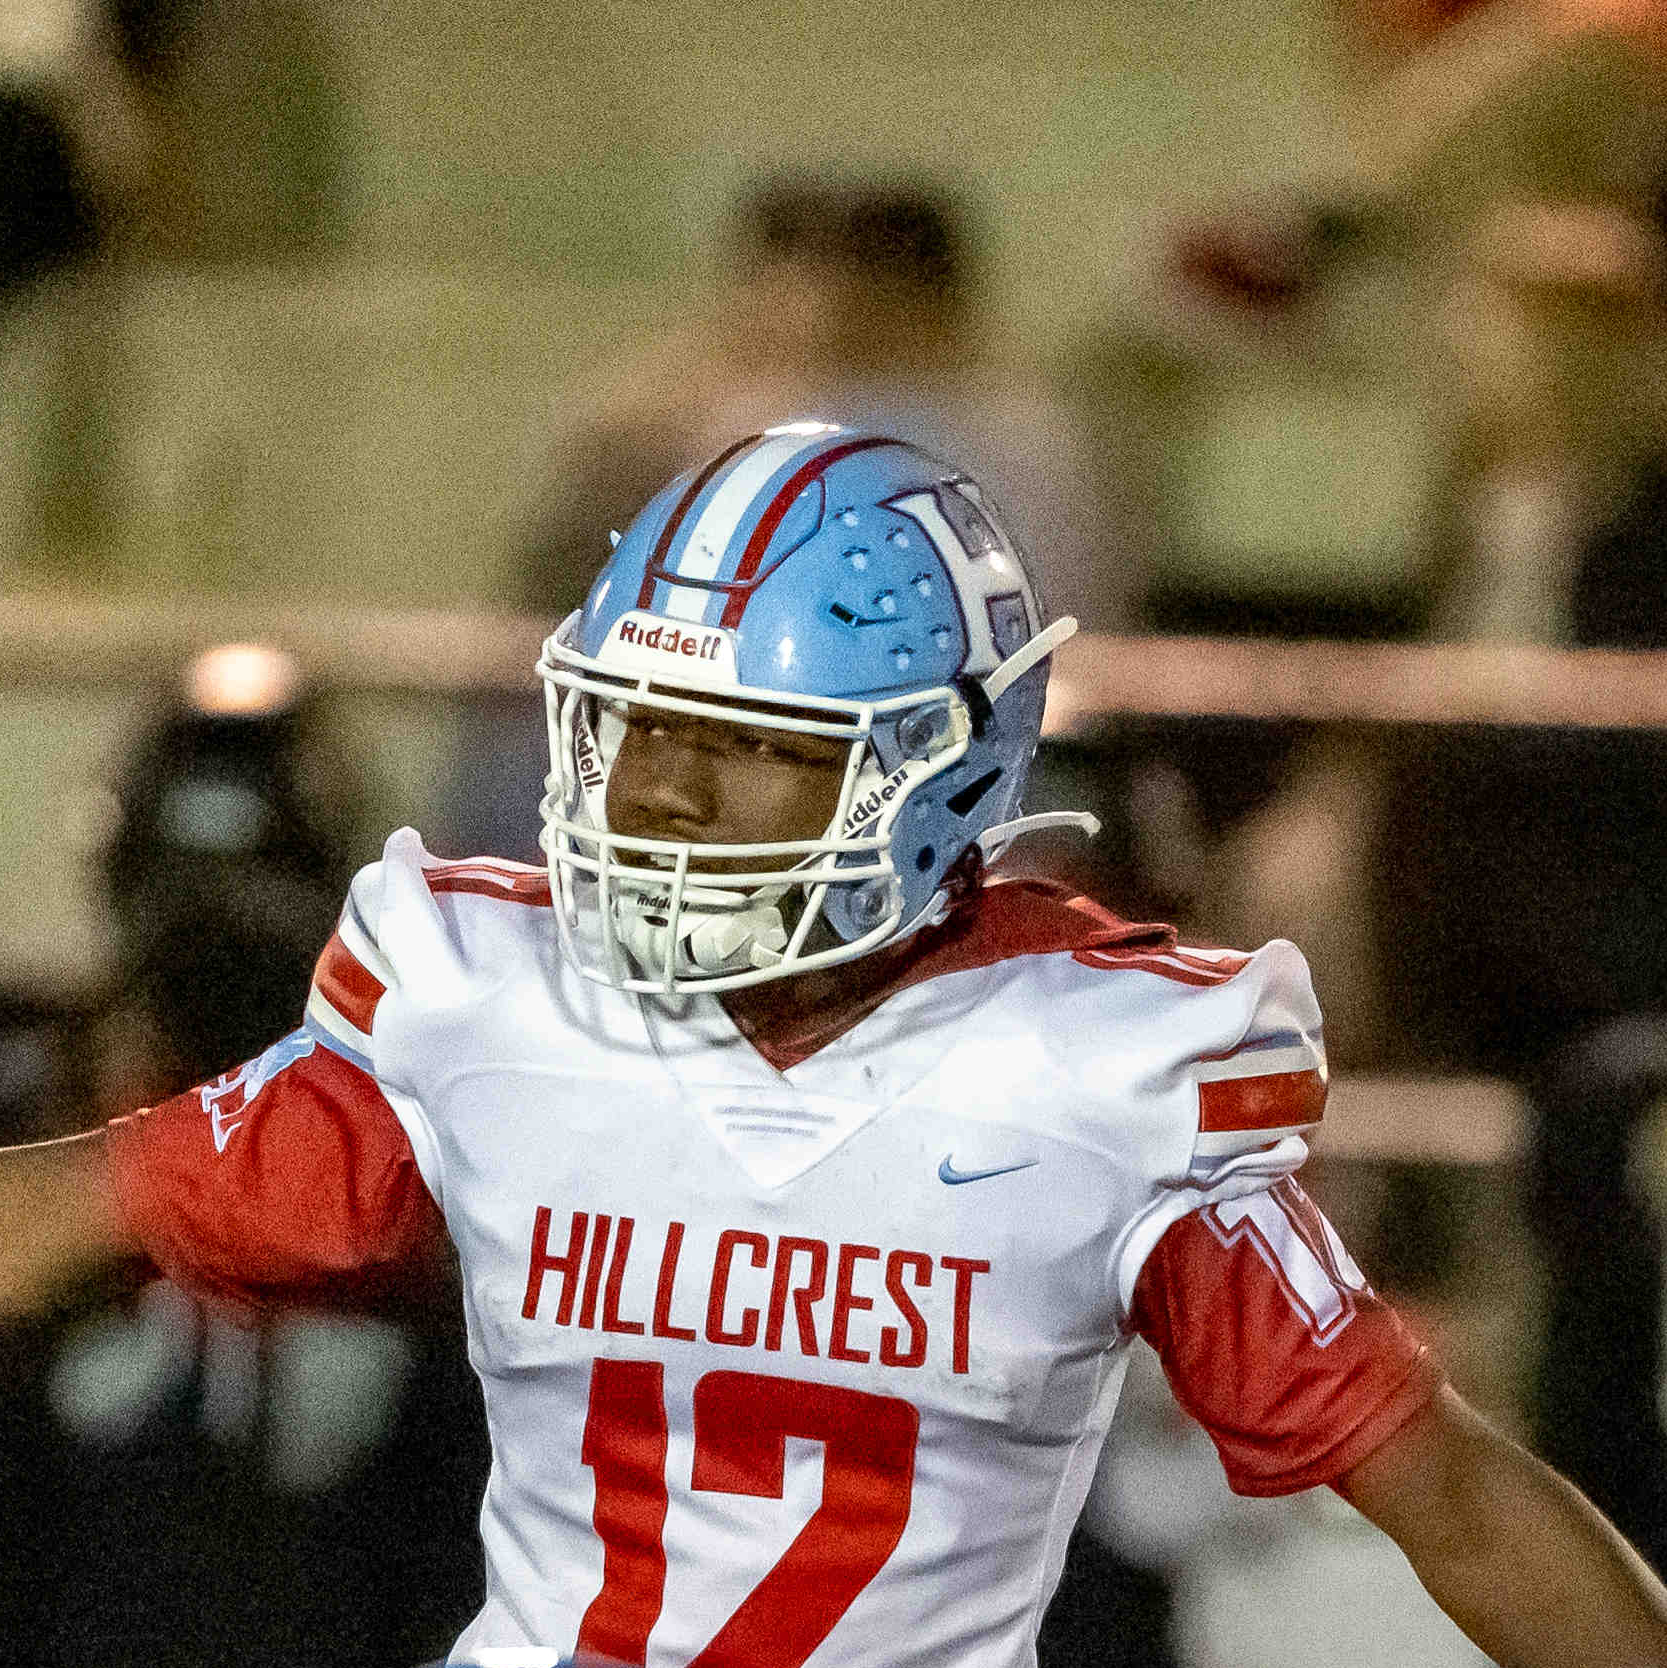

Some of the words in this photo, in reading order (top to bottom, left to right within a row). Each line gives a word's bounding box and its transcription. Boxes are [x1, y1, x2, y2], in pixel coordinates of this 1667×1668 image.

[619, 620, 721, 660] Riddell
[843, 769, 909, 835] iddell
[521, 1205, 991, 1376] HILLCREST
